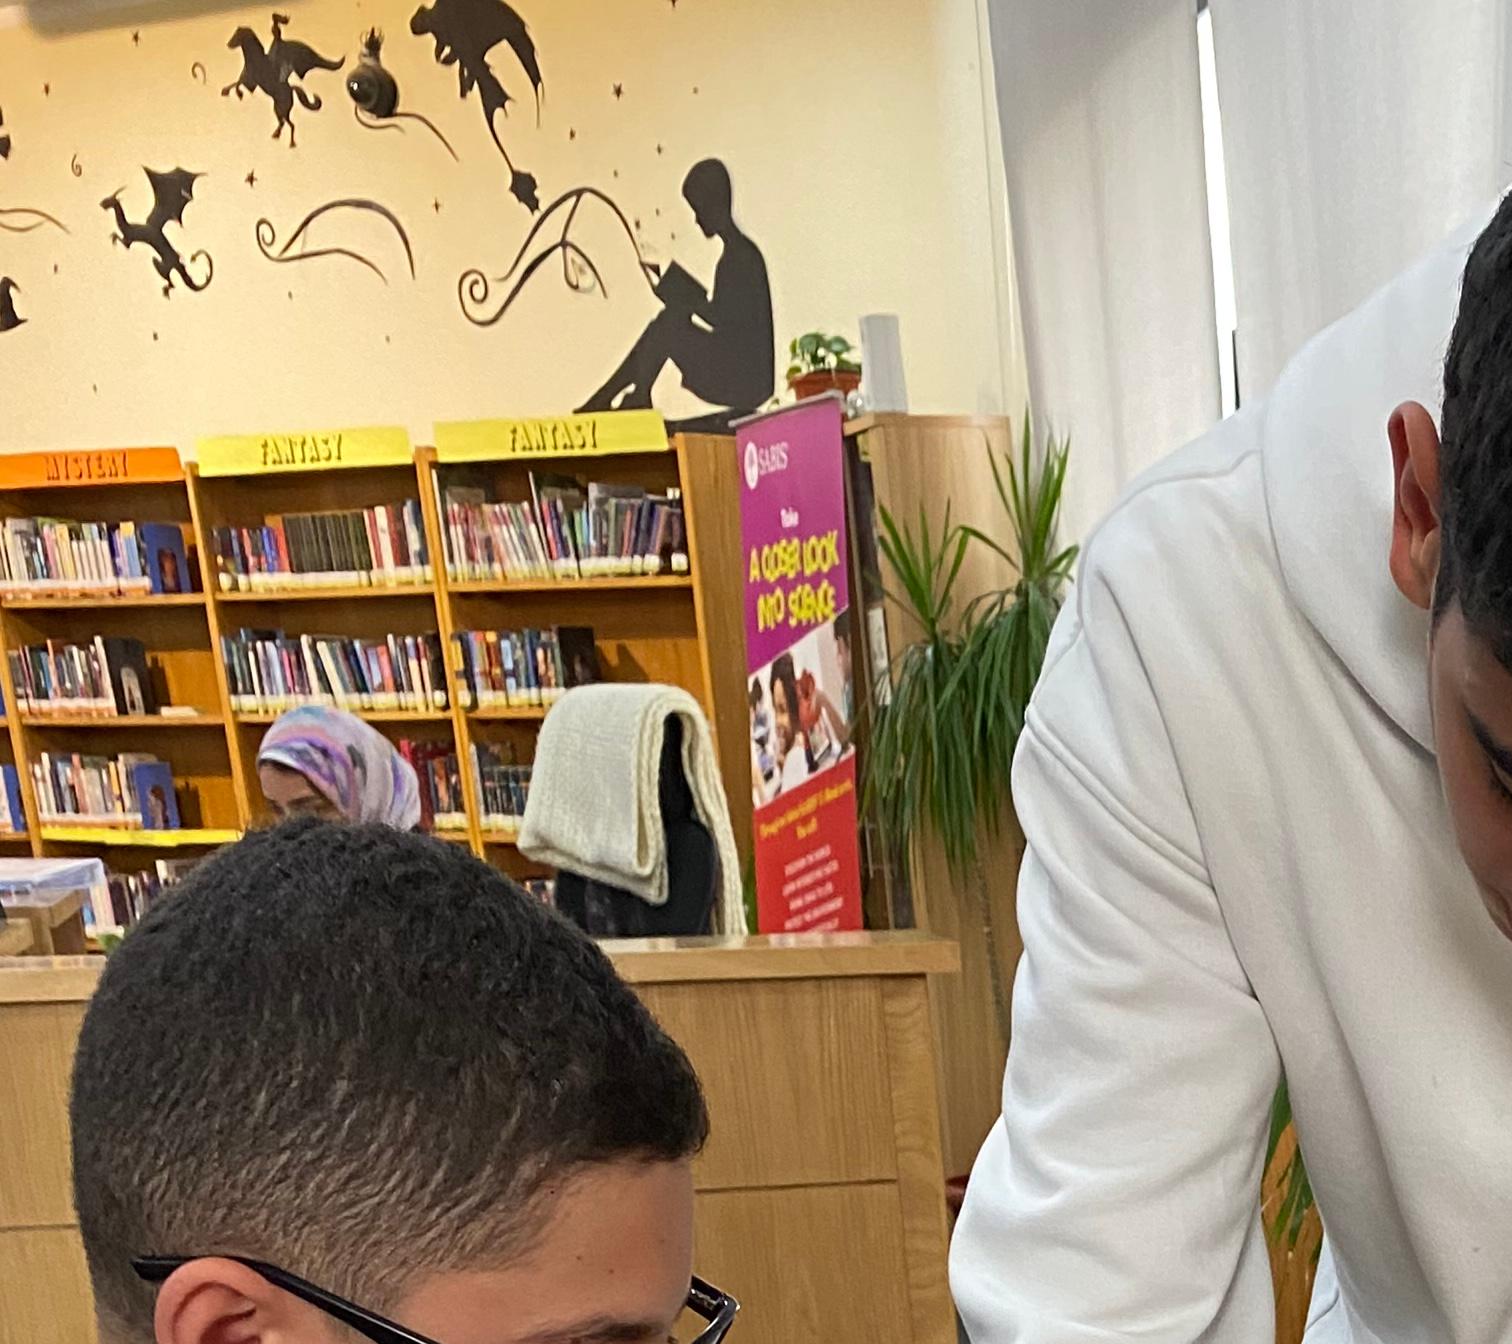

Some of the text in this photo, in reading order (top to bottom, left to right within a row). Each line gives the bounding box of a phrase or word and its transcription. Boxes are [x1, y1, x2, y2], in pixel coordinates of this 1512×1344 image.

[261, 434, 343, 465] FANTASY
[510, 419, 598, 451] FANTASY
[46, 452, 128, 480] MYSTERY
[750, 548, 761, 582] A
[803, 529, 840, 576] LOOK
